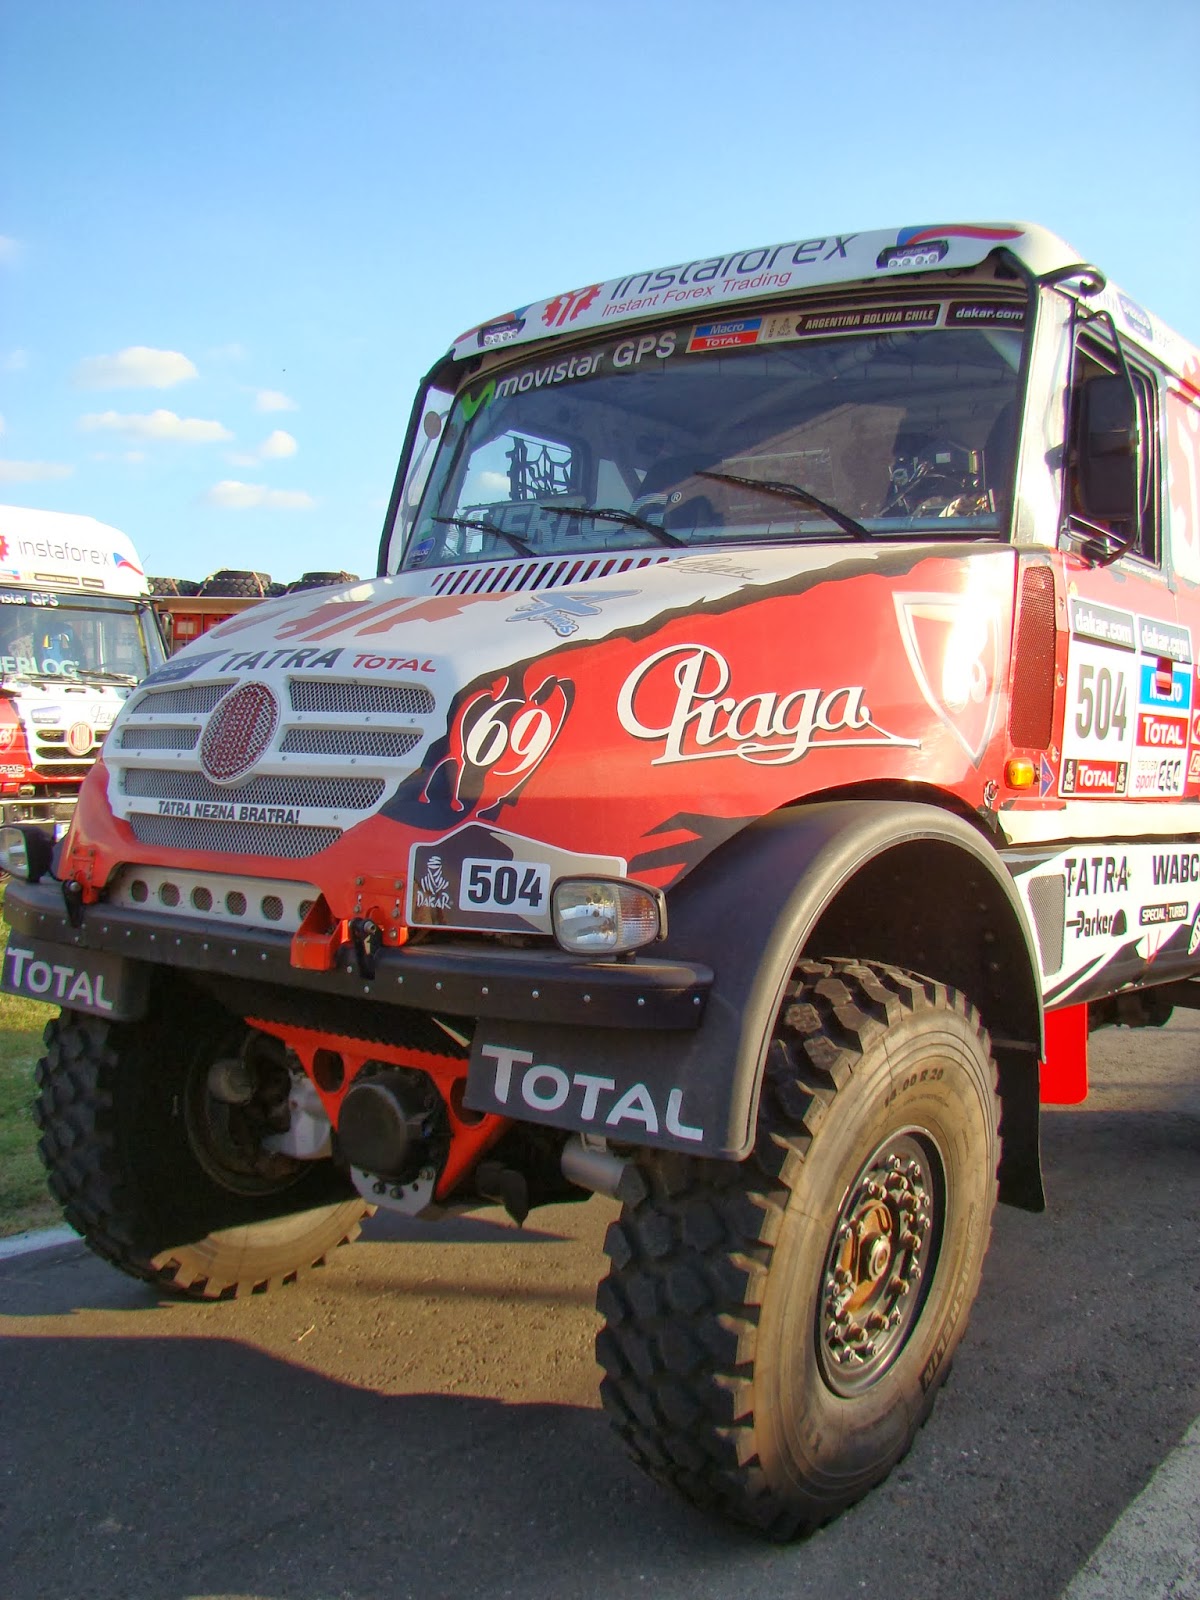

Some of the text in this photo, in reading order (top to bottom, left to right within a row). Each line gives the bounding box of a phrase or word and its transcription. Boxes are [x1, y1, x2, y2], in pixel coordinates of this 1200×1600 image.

[610, 233, 858, 301] instaforex
[601, 271, 792, 317] Instant Forex Trading
[709, 321, 745, 334] Macro
[804, 308, 935, 330] ARGENTINA BOLIVIA CHILE
[955, 307, 1024, 320] dakar.com
[705, 335, 741, 347] TOTAL
[495, 331, 676, 399] movistar GPS
[18, 535, 110, 566] instaforex
[31, 593, 59, 607] GPS
[1075, 608, 1133, 644] dakar.com
[1141, 620, 1190, 656] dakar.com
[219, 648, 346, 672] TATRA
[352, 654, 437, 673] TOTAL
[617, 643, 921, 766] Praga
[1075, 664, 1127, 742] 504
[466, 699, 551, 776] 69
[1143, 717, 1183, 745] TOTAL
[1079, 765, 1114, 787] TOTAL
[158, 800, 190, 817] TATRA
[240, 806, 301, 825] BRATRA!
[1065, 856, 1128, 897] TATRA
[1153, 853, 1200, 885] WABC
[416, 891, 451, 910] DAKAR
[467, 864, 543, 908] 504
[1075, 908, 1114, 938] Parker
[6, 946, 113, 1011] TOTAL
[481, 1043, 704, 1142] TOTAL
